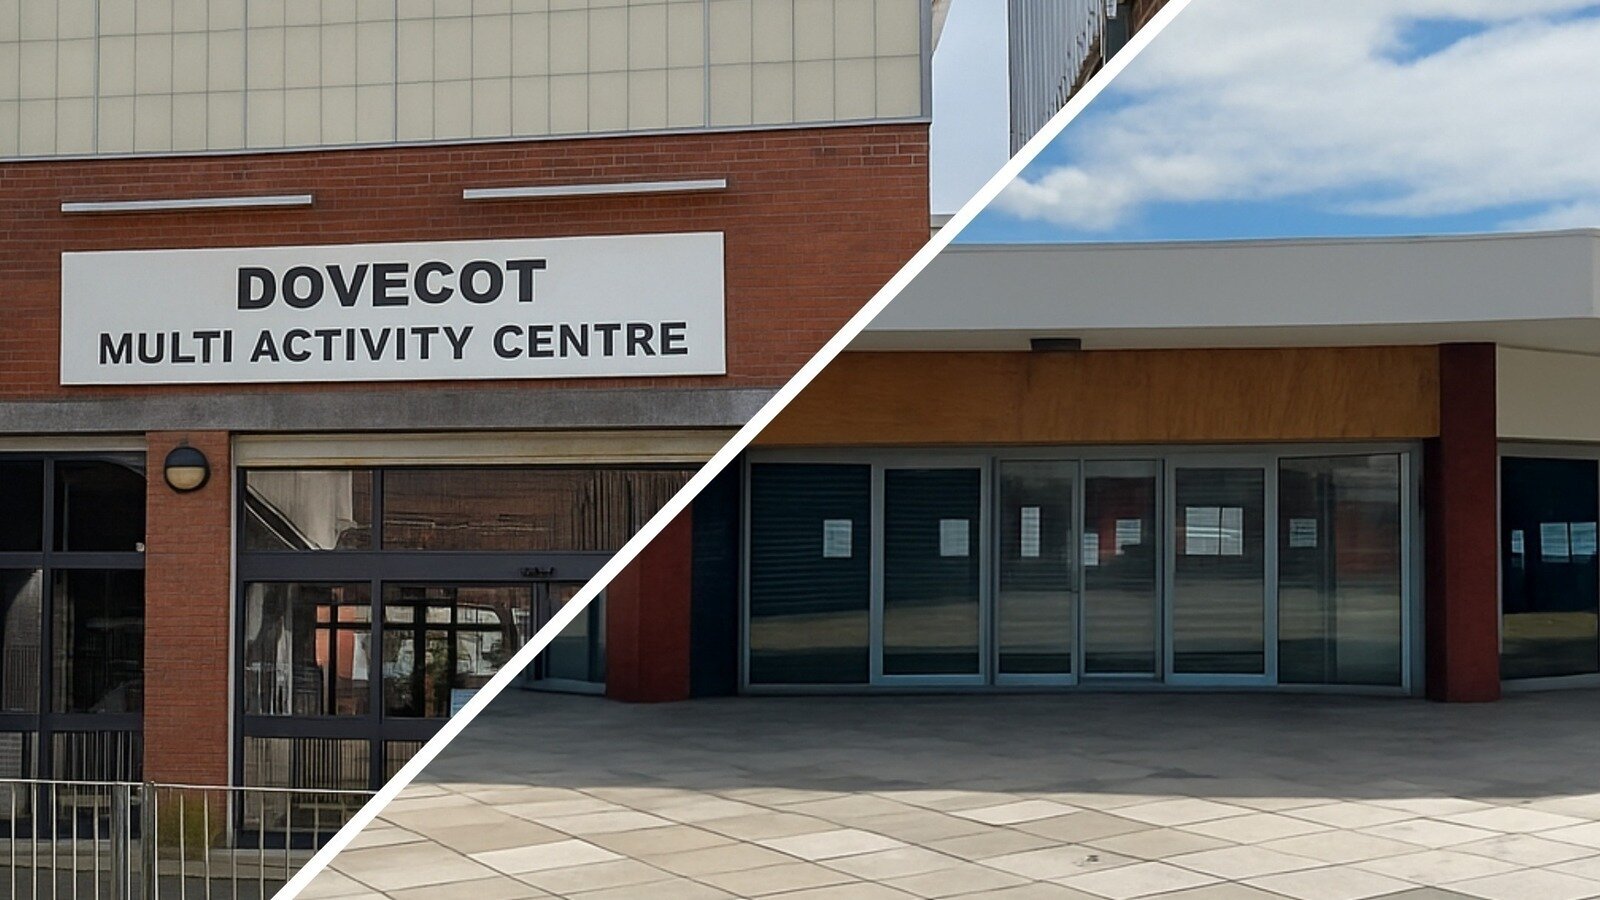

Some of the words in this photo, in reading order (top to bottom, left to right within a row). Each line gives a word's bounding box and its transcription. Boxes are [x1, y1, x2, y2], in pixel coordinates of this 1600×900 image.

[237, 258, 547, 311] DOVECOT
[99, 329, 233, 365] MULTI
[250, 325, 474, 363] ACTIVITY
[493, 321, 689, 359] CENTRE
